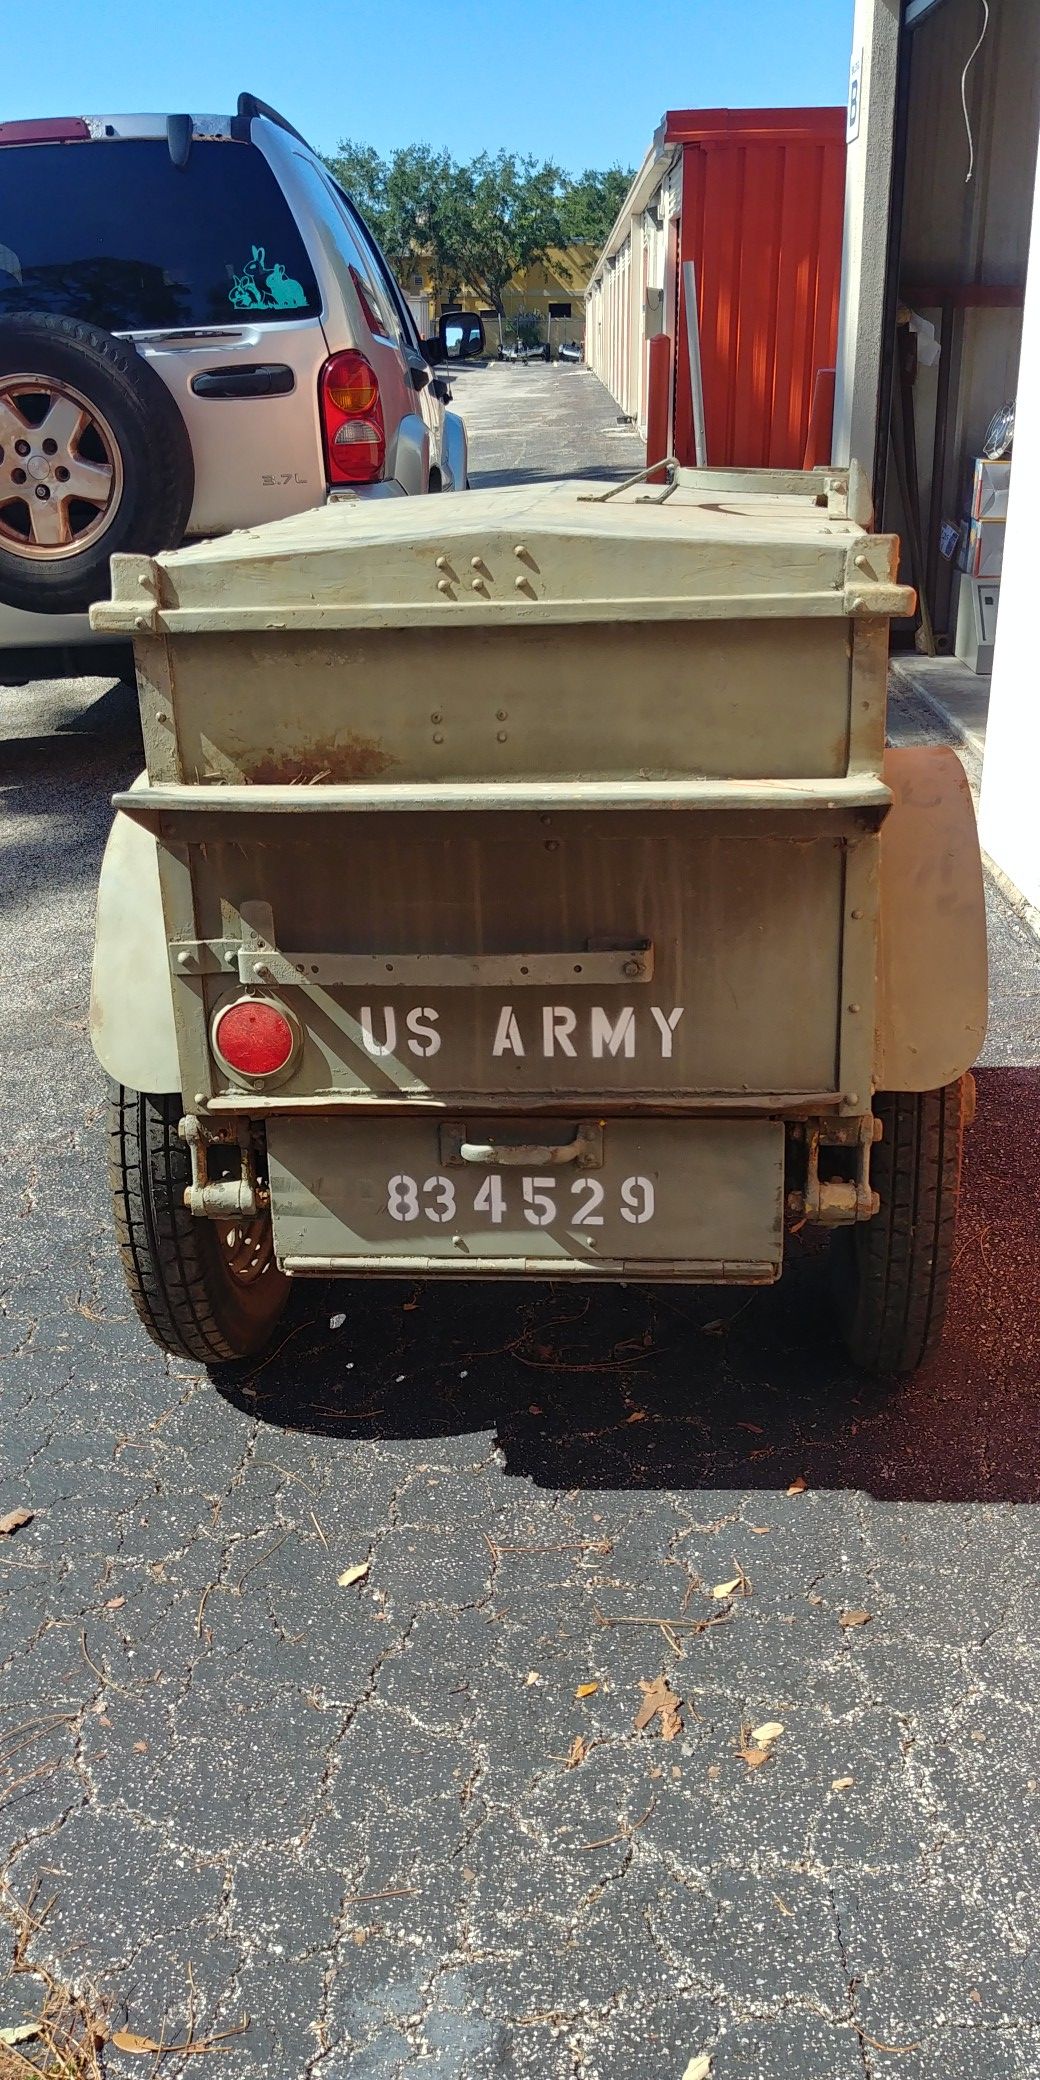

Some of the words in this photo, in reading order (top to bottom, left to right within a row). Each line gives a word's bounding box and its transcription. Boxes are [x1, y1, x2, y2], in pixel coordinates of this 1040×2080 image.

[850, 79, 858, 127] B
[261, 473, 308, 486] 3.7L
[360, 1006, 442, 1057] US
[492, 1006, 685, 1058] ARMY
[387, 1174, 655, 1225] 834529
